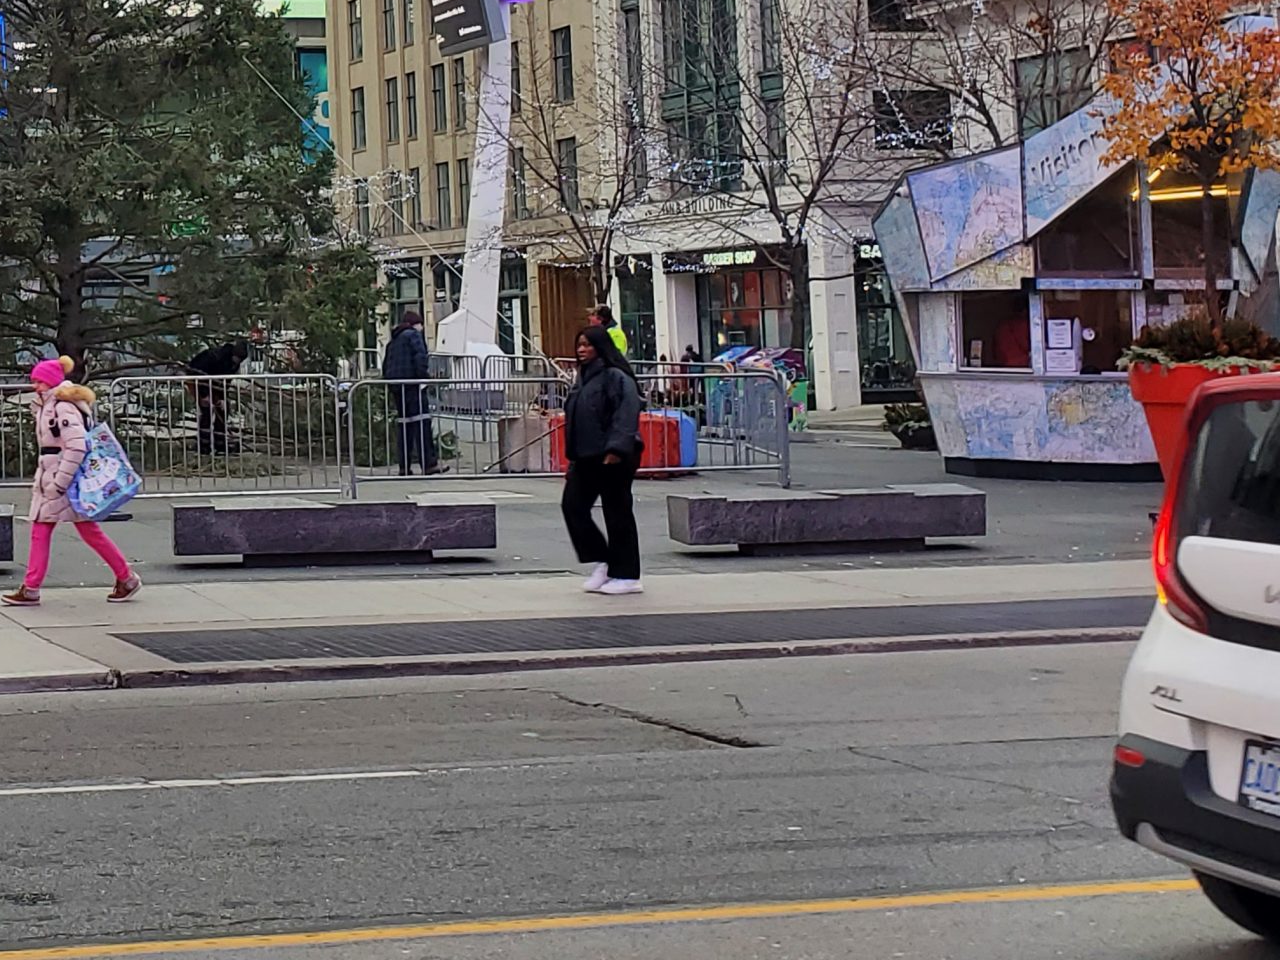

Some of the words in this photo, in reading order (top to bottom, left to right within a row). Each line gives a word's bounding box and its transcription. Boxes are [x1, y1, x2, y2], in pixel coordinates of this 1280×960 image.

[1031, 130, 1098, 187] Visitor
[685, 194, 733, 213] BUILDING
[735, 250, 756, 264] SHOP
